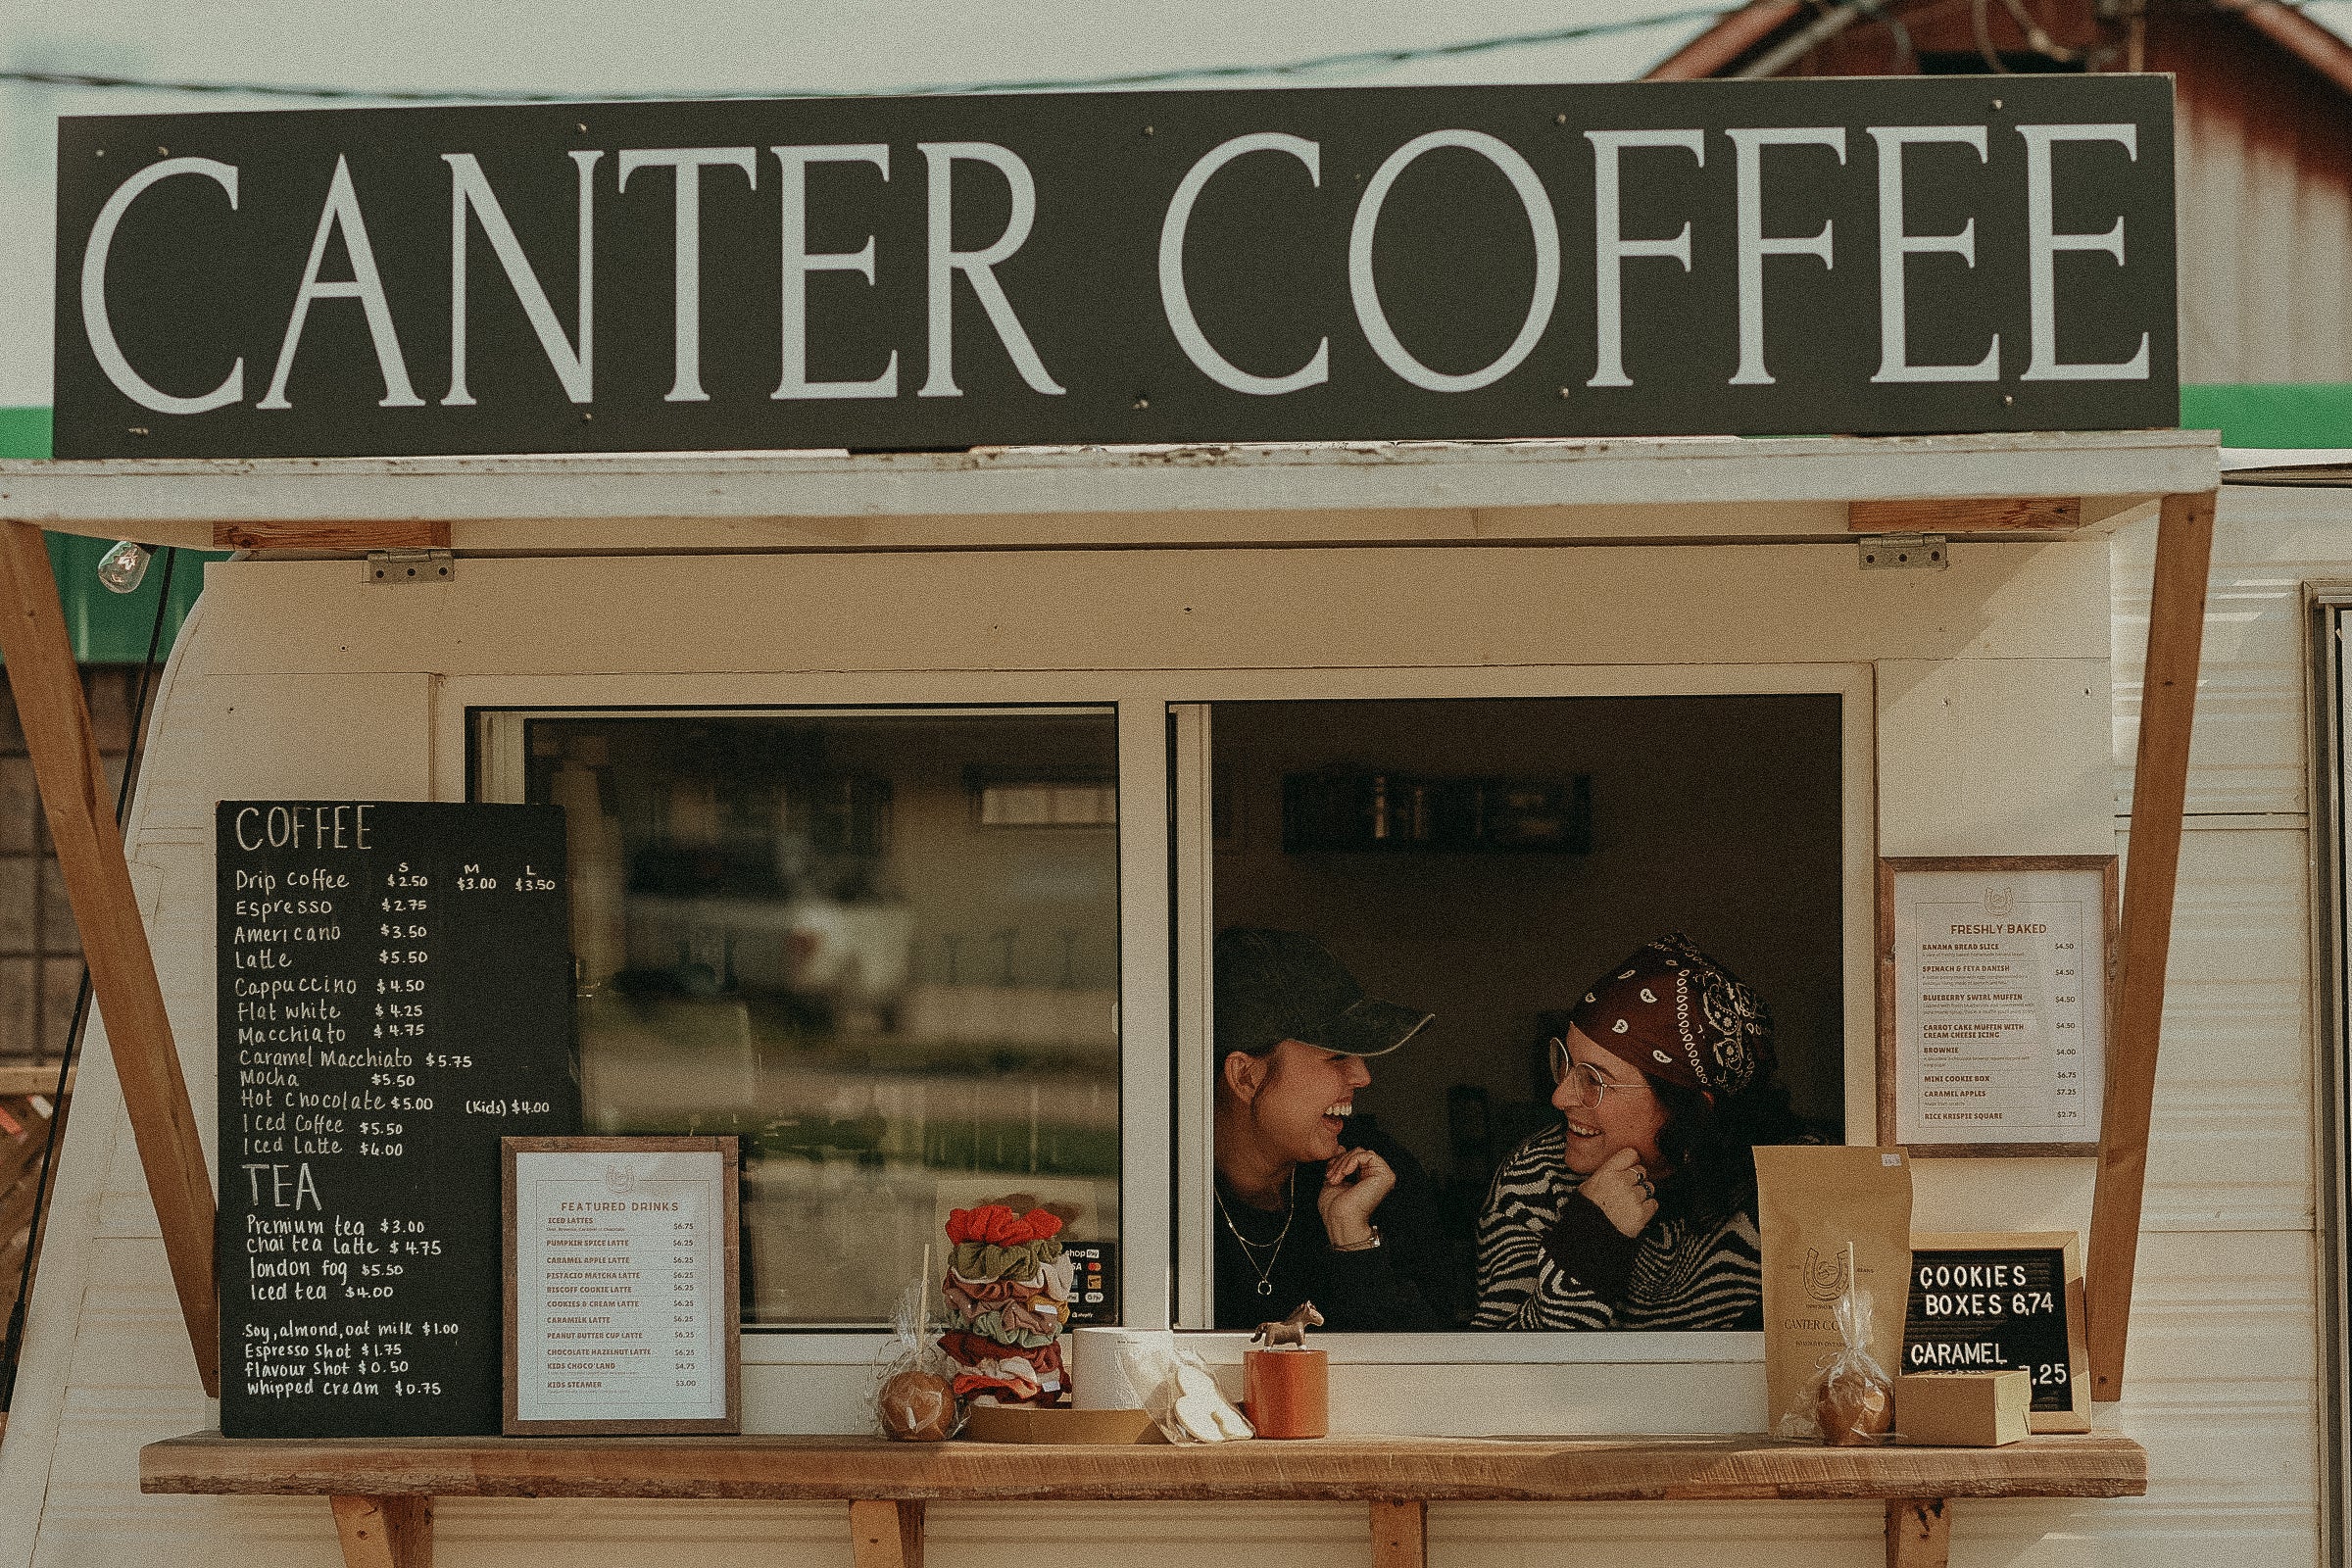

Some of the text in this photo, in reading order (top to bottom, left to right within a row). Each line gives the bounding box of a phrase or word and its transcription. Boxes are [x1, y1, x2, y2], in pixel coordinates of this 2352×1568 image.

[80, 122, 2151, 416] CANTER COFFEE
[236, 806, 373, 851] COFFEE
[399, 862, 535, 875] S M L
[237, 870, 275, 895] Drip
[388, 874, 427, 886] $2.50
[458, 878, 496, 891] $3.00
[515, 878, 555, 891] $3.50
[237, 899, 426, 922] Espresso $2.75
[234, 924, 426, 944] Americano $3.50
[1950, 924, 2047, 935] FRESHLY BAKED
[379, 950, 427, 963] $5.50
[235, 978, 424, 1001] Cappuccino $4.50
[286, 999, 340, 1019] white
[375, 1004, 422, 1017] $4.25
[239, 1023, 423, 1048] Macchiato $4.75
[240, 1044, 312, 1066] Caramel
[426, 1053, 471, 1067] $5.75
[241, 1067, 415, 1087] Mocha $5.50
[242, 1089, 271, 1107] Hot
[391, 1097, 433, 1109] $5.00
[466, 1100, 506, 1116] (Kids)
[512, 1100, 549, 1114] $4.00
[360, 1122, 402, 1135] $5.50
[242, 1163, 321, 1210] TEA
[561, 1201, 678, 1211] FEATURED DRINKS
[247, 1214, 424, 1236] Premium tea $3.00
[293, 1235, 321, 1251] tea
[390, 1241, 441, 1255] $4.75
[322, 1260, 347, 1286] fog
[362, 1264, 403, 1276] $5.50
[1920, 1265, 2027, 1289] COOKIES
[252, 1283, 393, 1300] Iced tea $4.00
[1926, 1294, 2002, 1316] BOXES
[378, 1322, 413, 1336] milk
[422, 1322, 459, 1336] $1.00
[245, 1343, 309, 1361] Espresso
[362, 1344, 401, 1356] $1.75
[1911, 1343, 2008, 1366] CARAMEL
[359, 1360, 408, 1374] $0.50
[2019, 1364, 2067, 1385] .25
[248, 1379, 441, 1398] whipped cream $0.75
